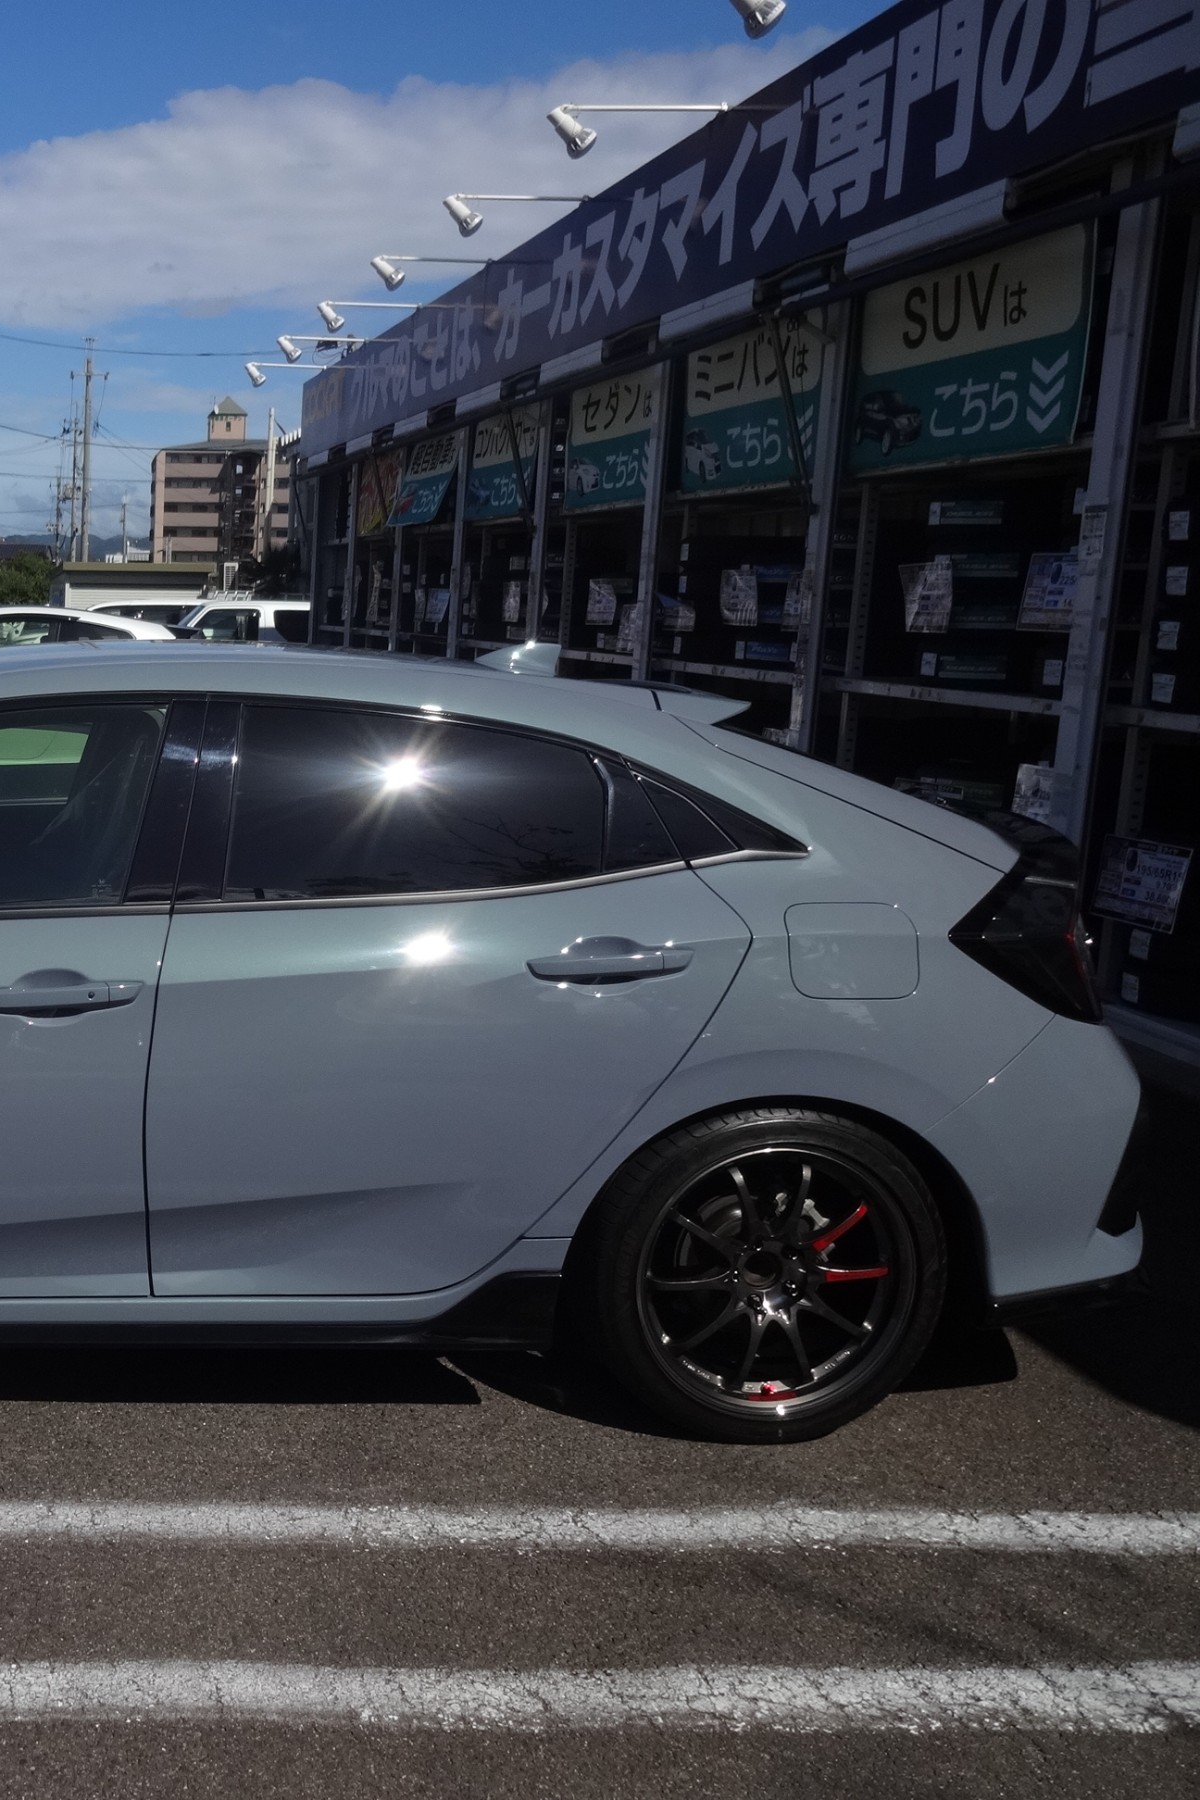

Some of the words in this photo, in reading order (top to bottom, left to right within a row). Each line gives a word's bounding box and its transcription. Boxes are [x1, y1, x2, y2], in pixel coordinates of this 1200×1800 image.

[902, 262, 1027, 349] SUVは
[582, 381, 653, 433] セダンは
[929, 371, 1019, 437] こちら
[602, 448, 639, 489] こちら
[726, 418, 782, 469] こちら
[491, 473, 517, 506] こちら
